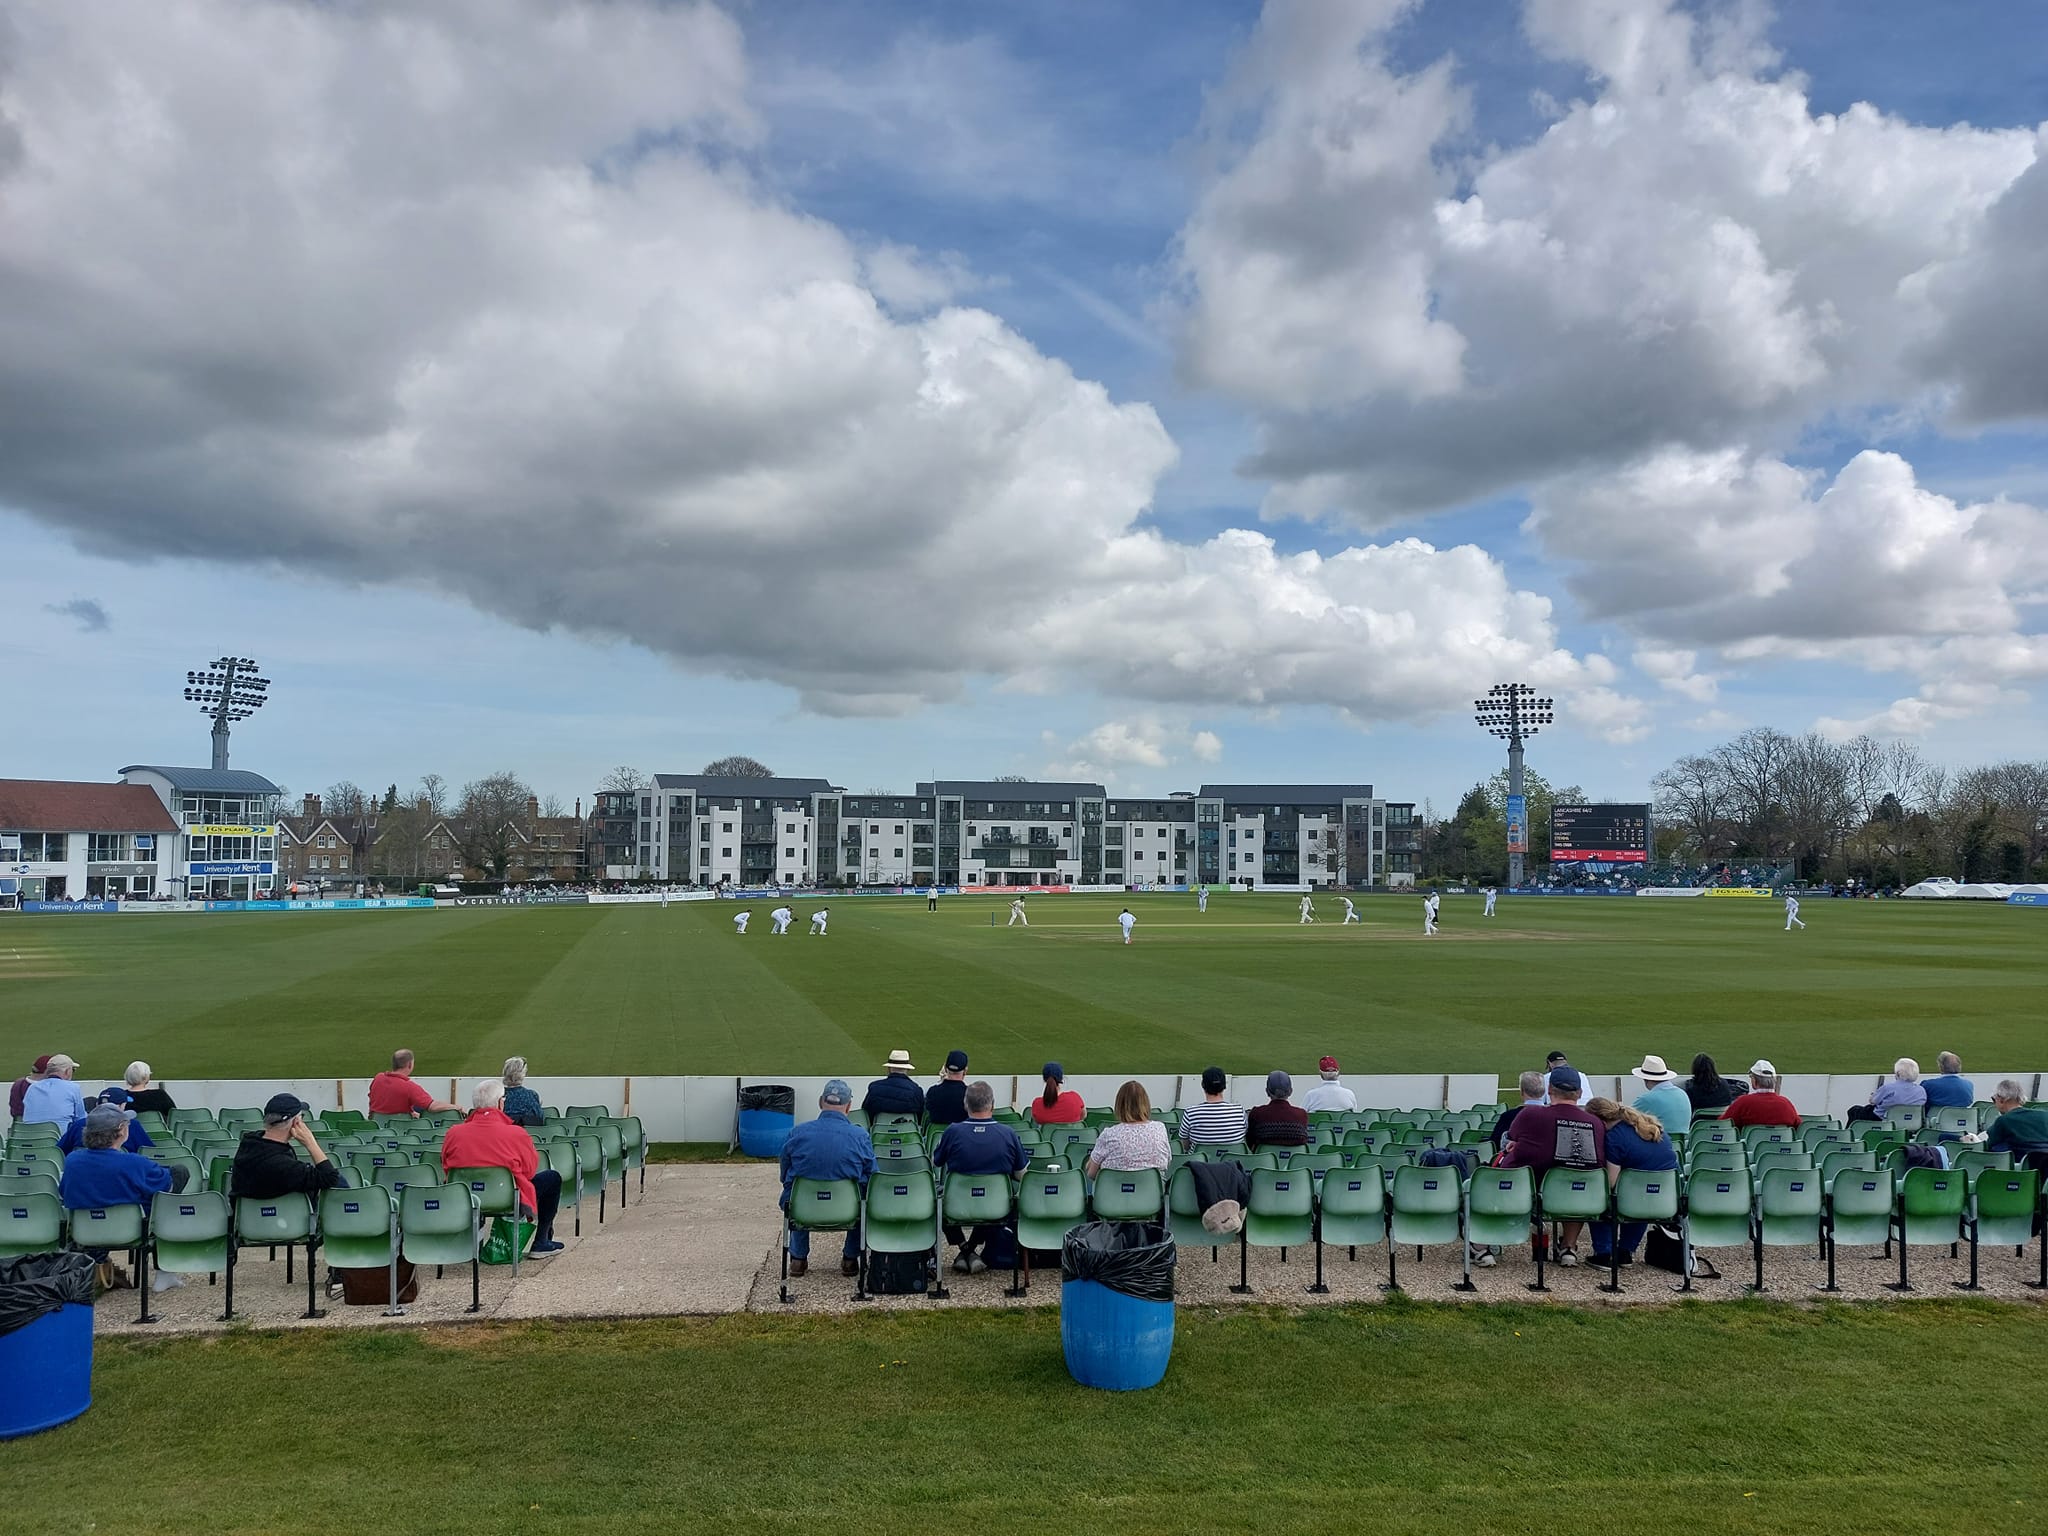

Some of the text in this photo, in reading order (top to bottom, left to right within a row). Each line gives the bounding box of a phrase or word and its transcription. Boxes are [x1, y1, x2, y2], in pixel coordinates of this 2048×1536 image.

[241, 864, 261, 872] Kent
[471, 897, 521, 905] CASTORE
[39, 902, 74, 912] University
[83, 902, 105, 910] Kent
